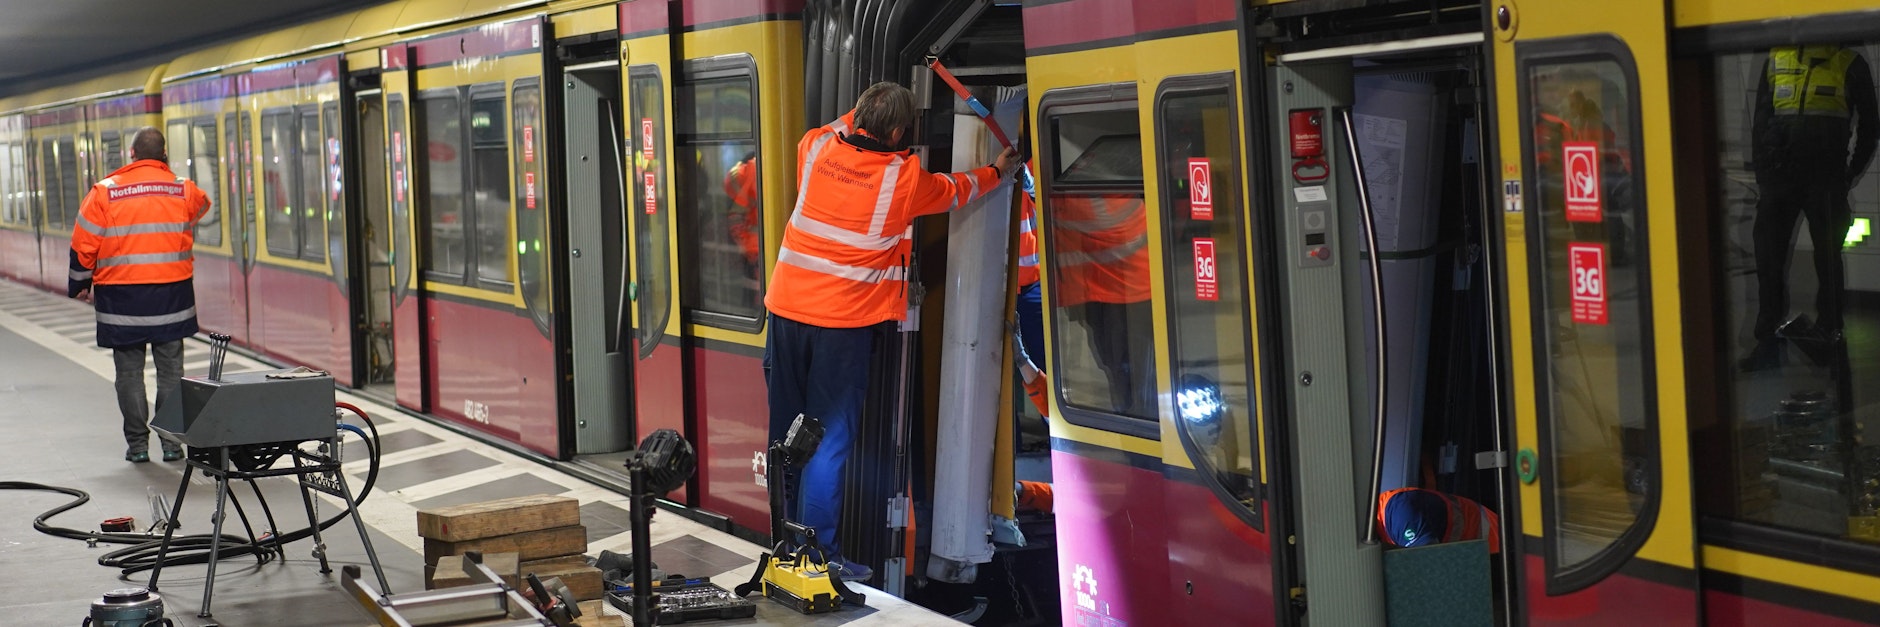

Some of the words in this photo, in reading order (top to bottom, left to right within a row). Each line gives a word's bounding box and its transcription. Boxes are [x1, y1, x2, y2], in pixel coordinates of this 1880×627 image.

[817, 166, 835, 179] Werk
[837, 174, 874, 189] Wannsee
[110, 184, 182, 198] Notfallmanager
[1198, 257, 1213, 278] 3G
[1576, 267, 1599, 295] 3G
